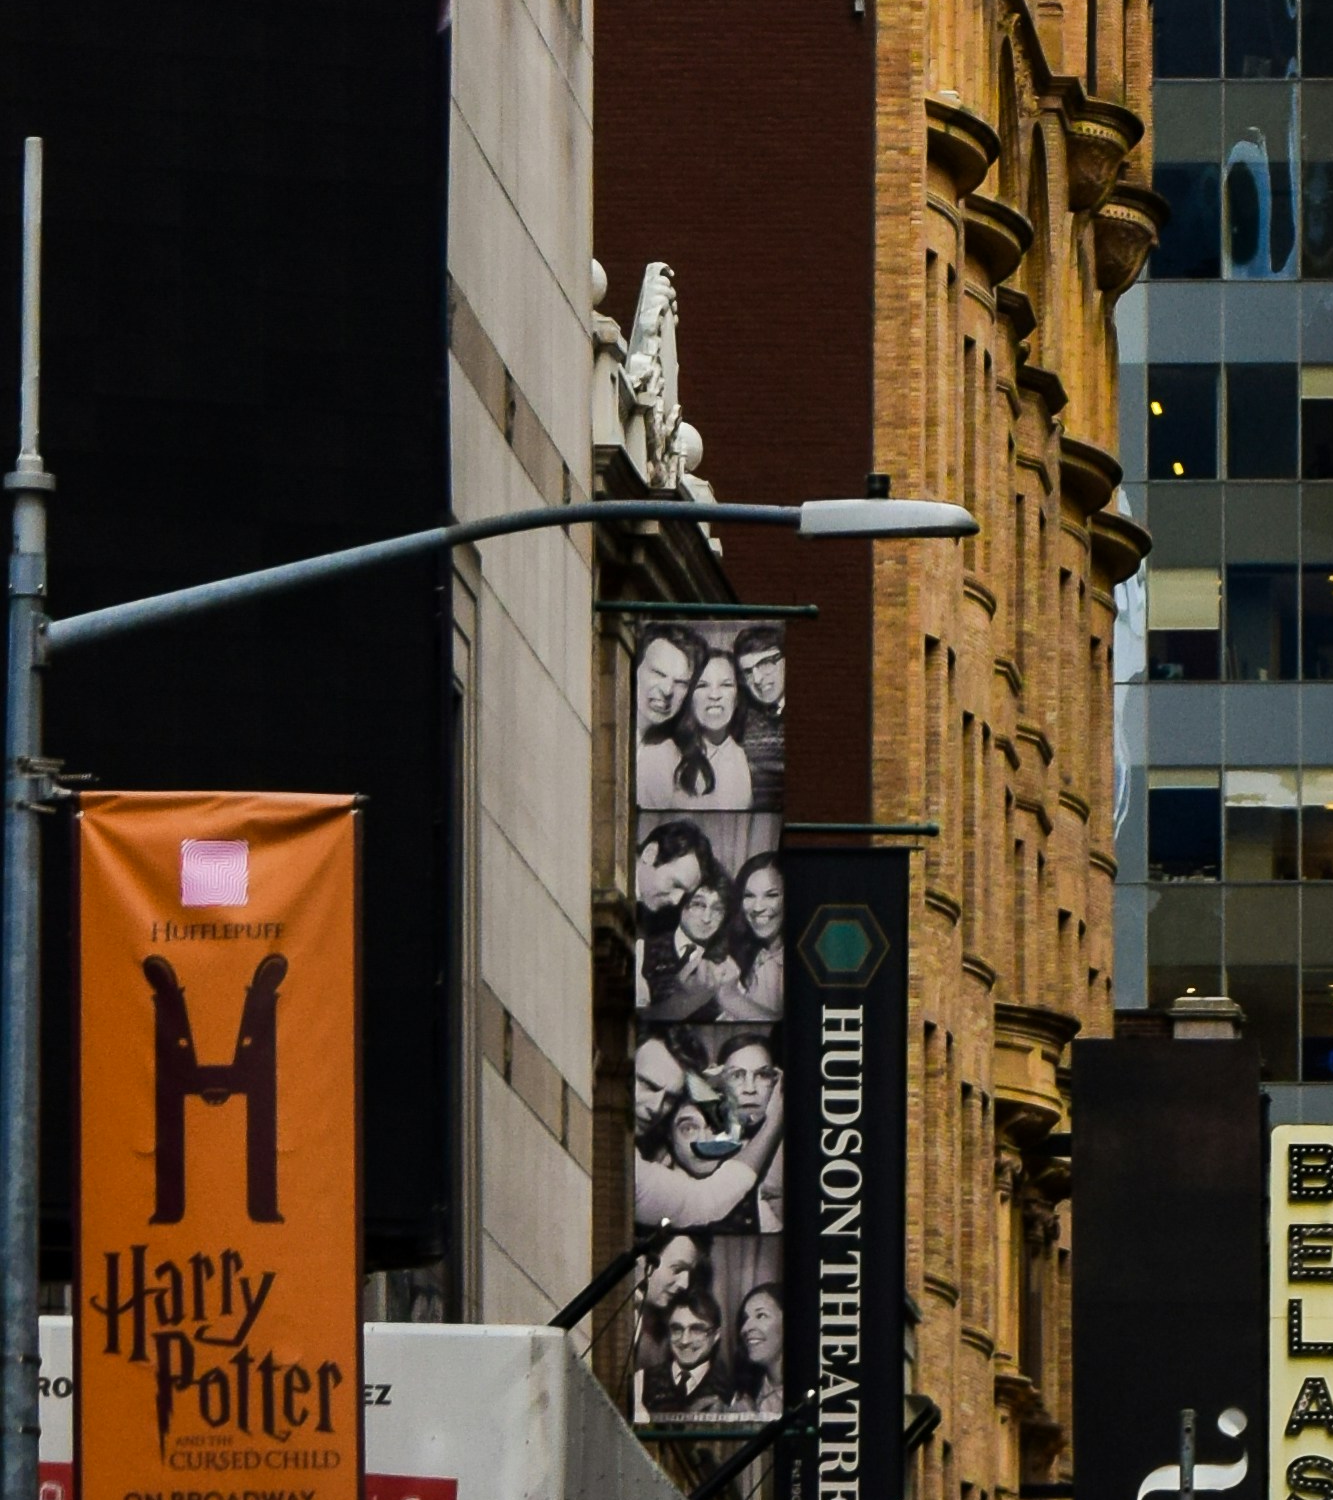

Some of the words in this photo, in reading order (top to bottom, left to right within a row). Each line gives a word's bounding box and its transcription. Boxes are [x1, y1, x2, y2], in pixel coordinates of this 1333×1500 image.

[818, 1004, 864, 1238] HUDSON
[90, 1243, 277, 1363] Harry
[151, 1330, 343, 1463] Potter
[169, 1449, 260, 1472] CURSED
[265, 1449, 341, 1471] CHILD
